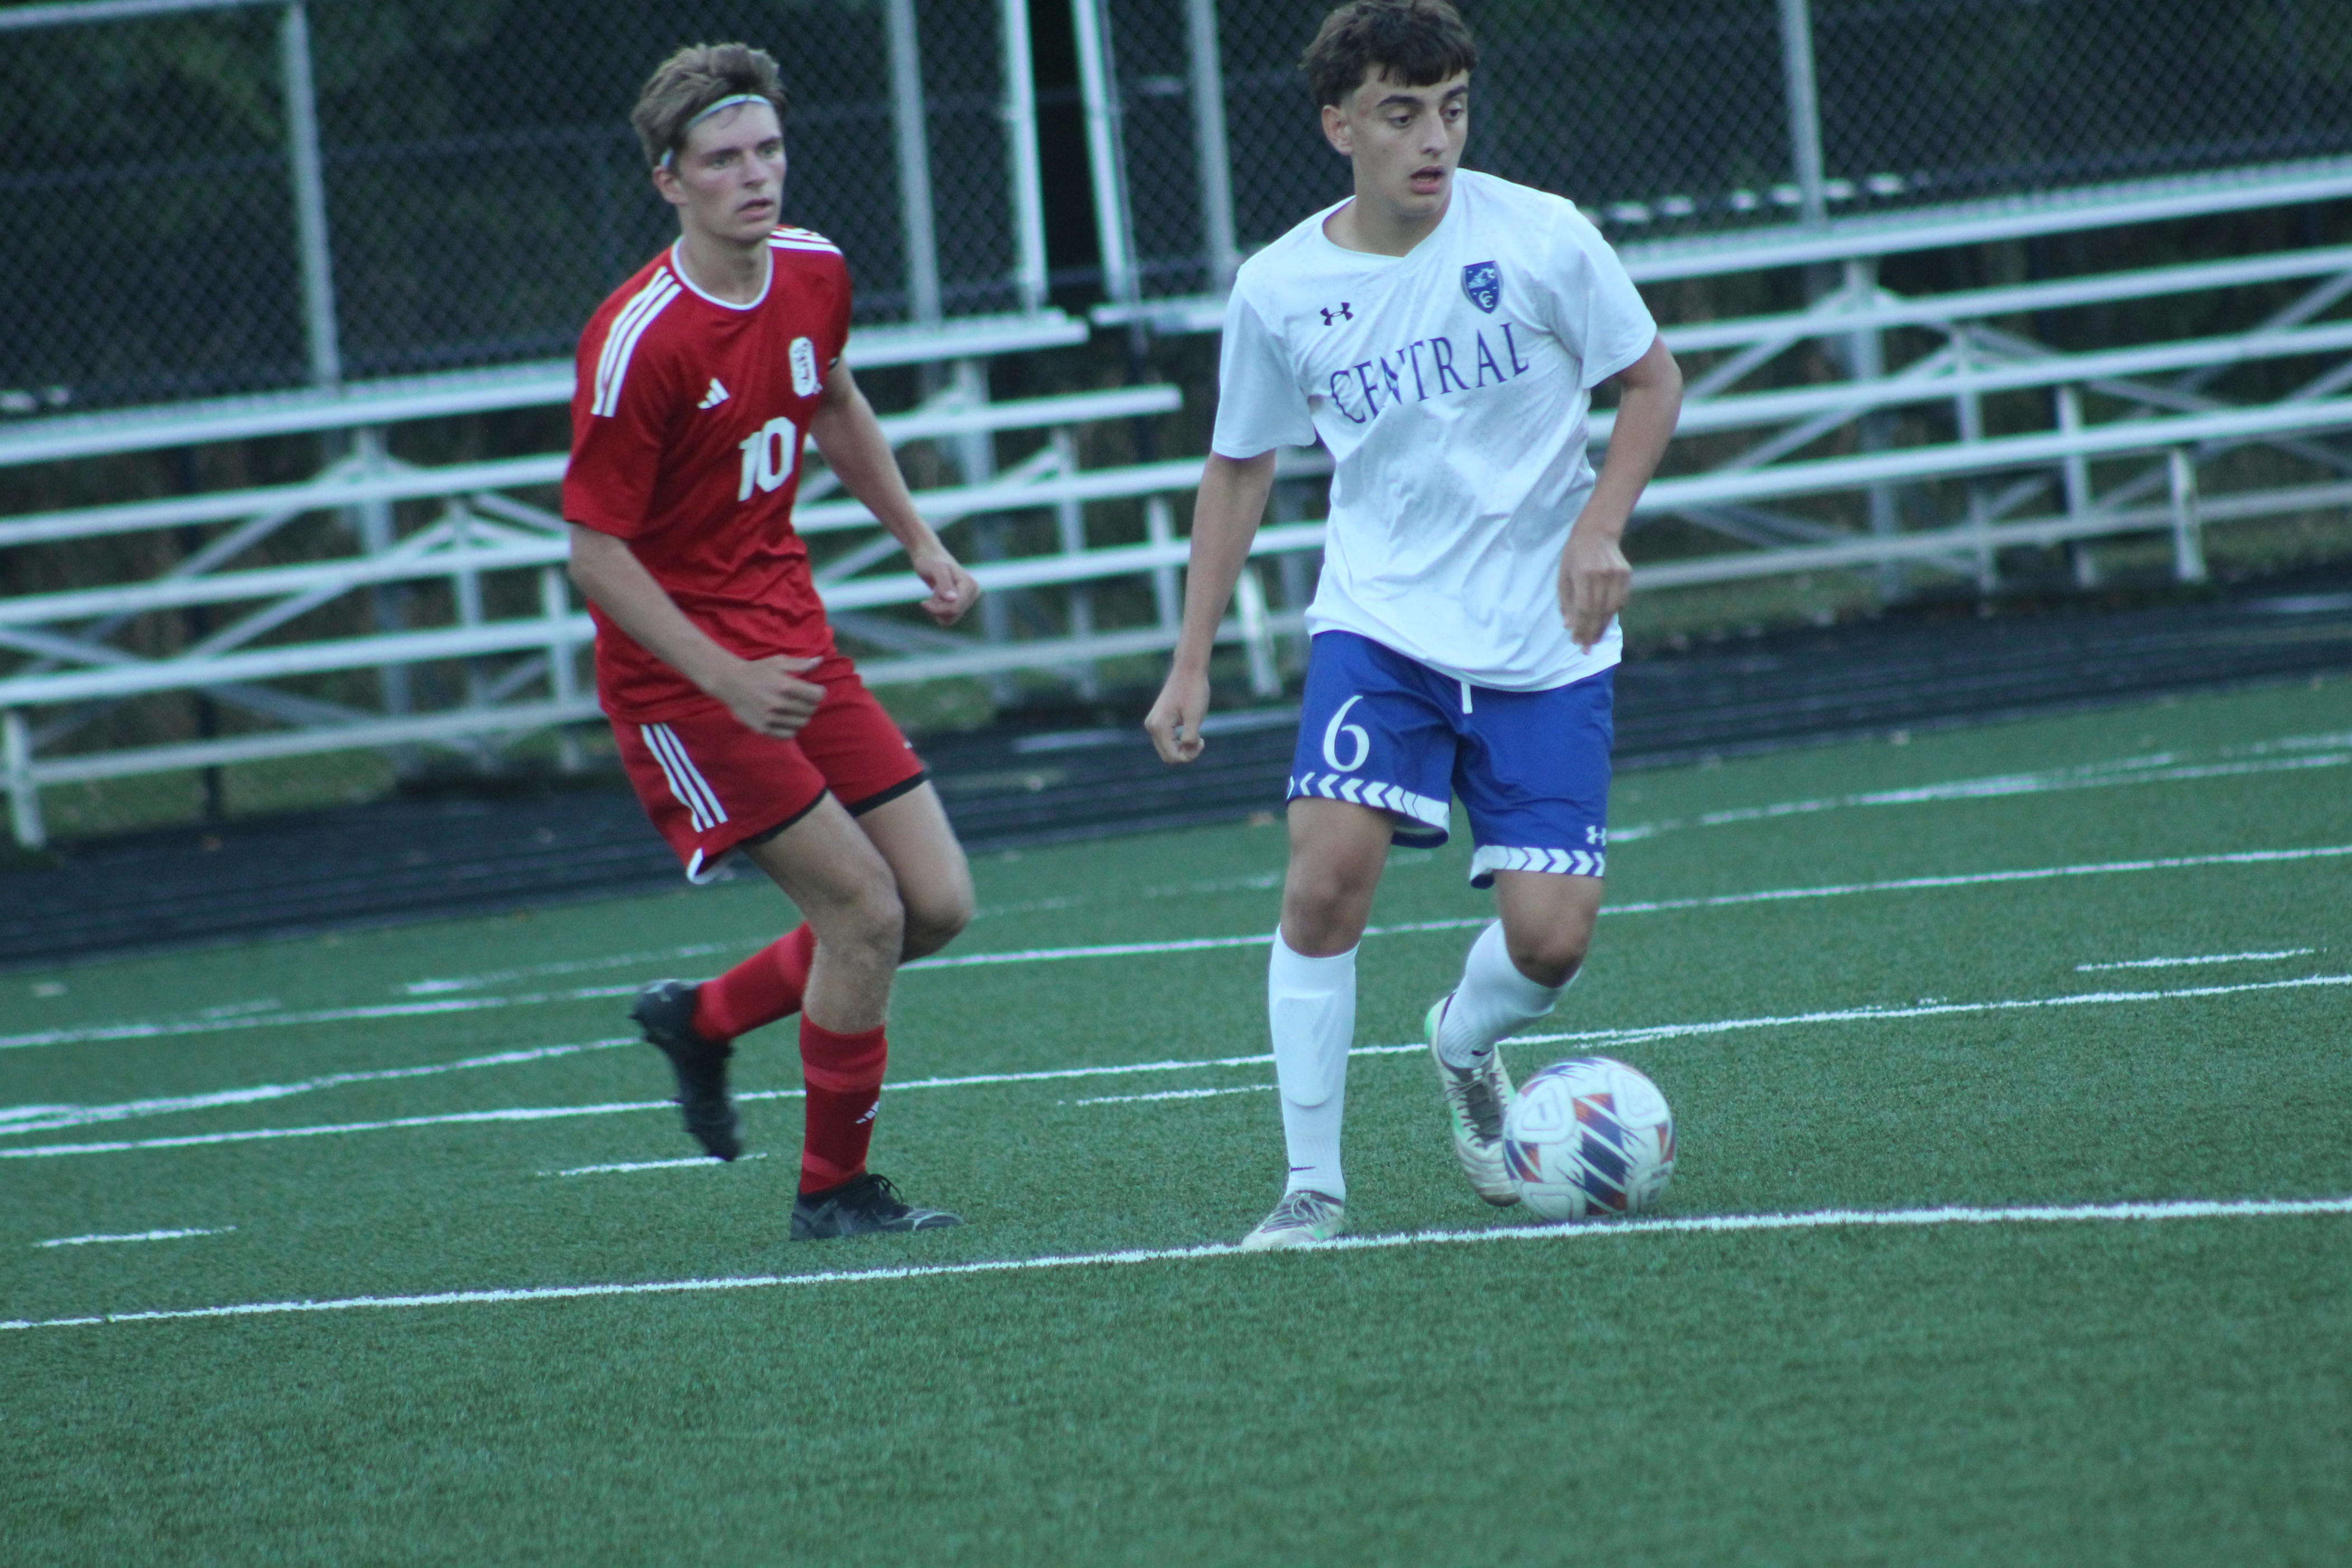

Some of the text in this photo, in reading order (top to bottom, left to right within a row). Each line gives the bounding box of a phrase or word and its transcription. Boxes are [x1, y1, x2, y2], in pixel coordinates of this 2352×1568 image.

[1330, 322, 1529, 423] CENTRAL
[738, 416, 797, 502] 10
[1323, 695, 1370, 772] 6
